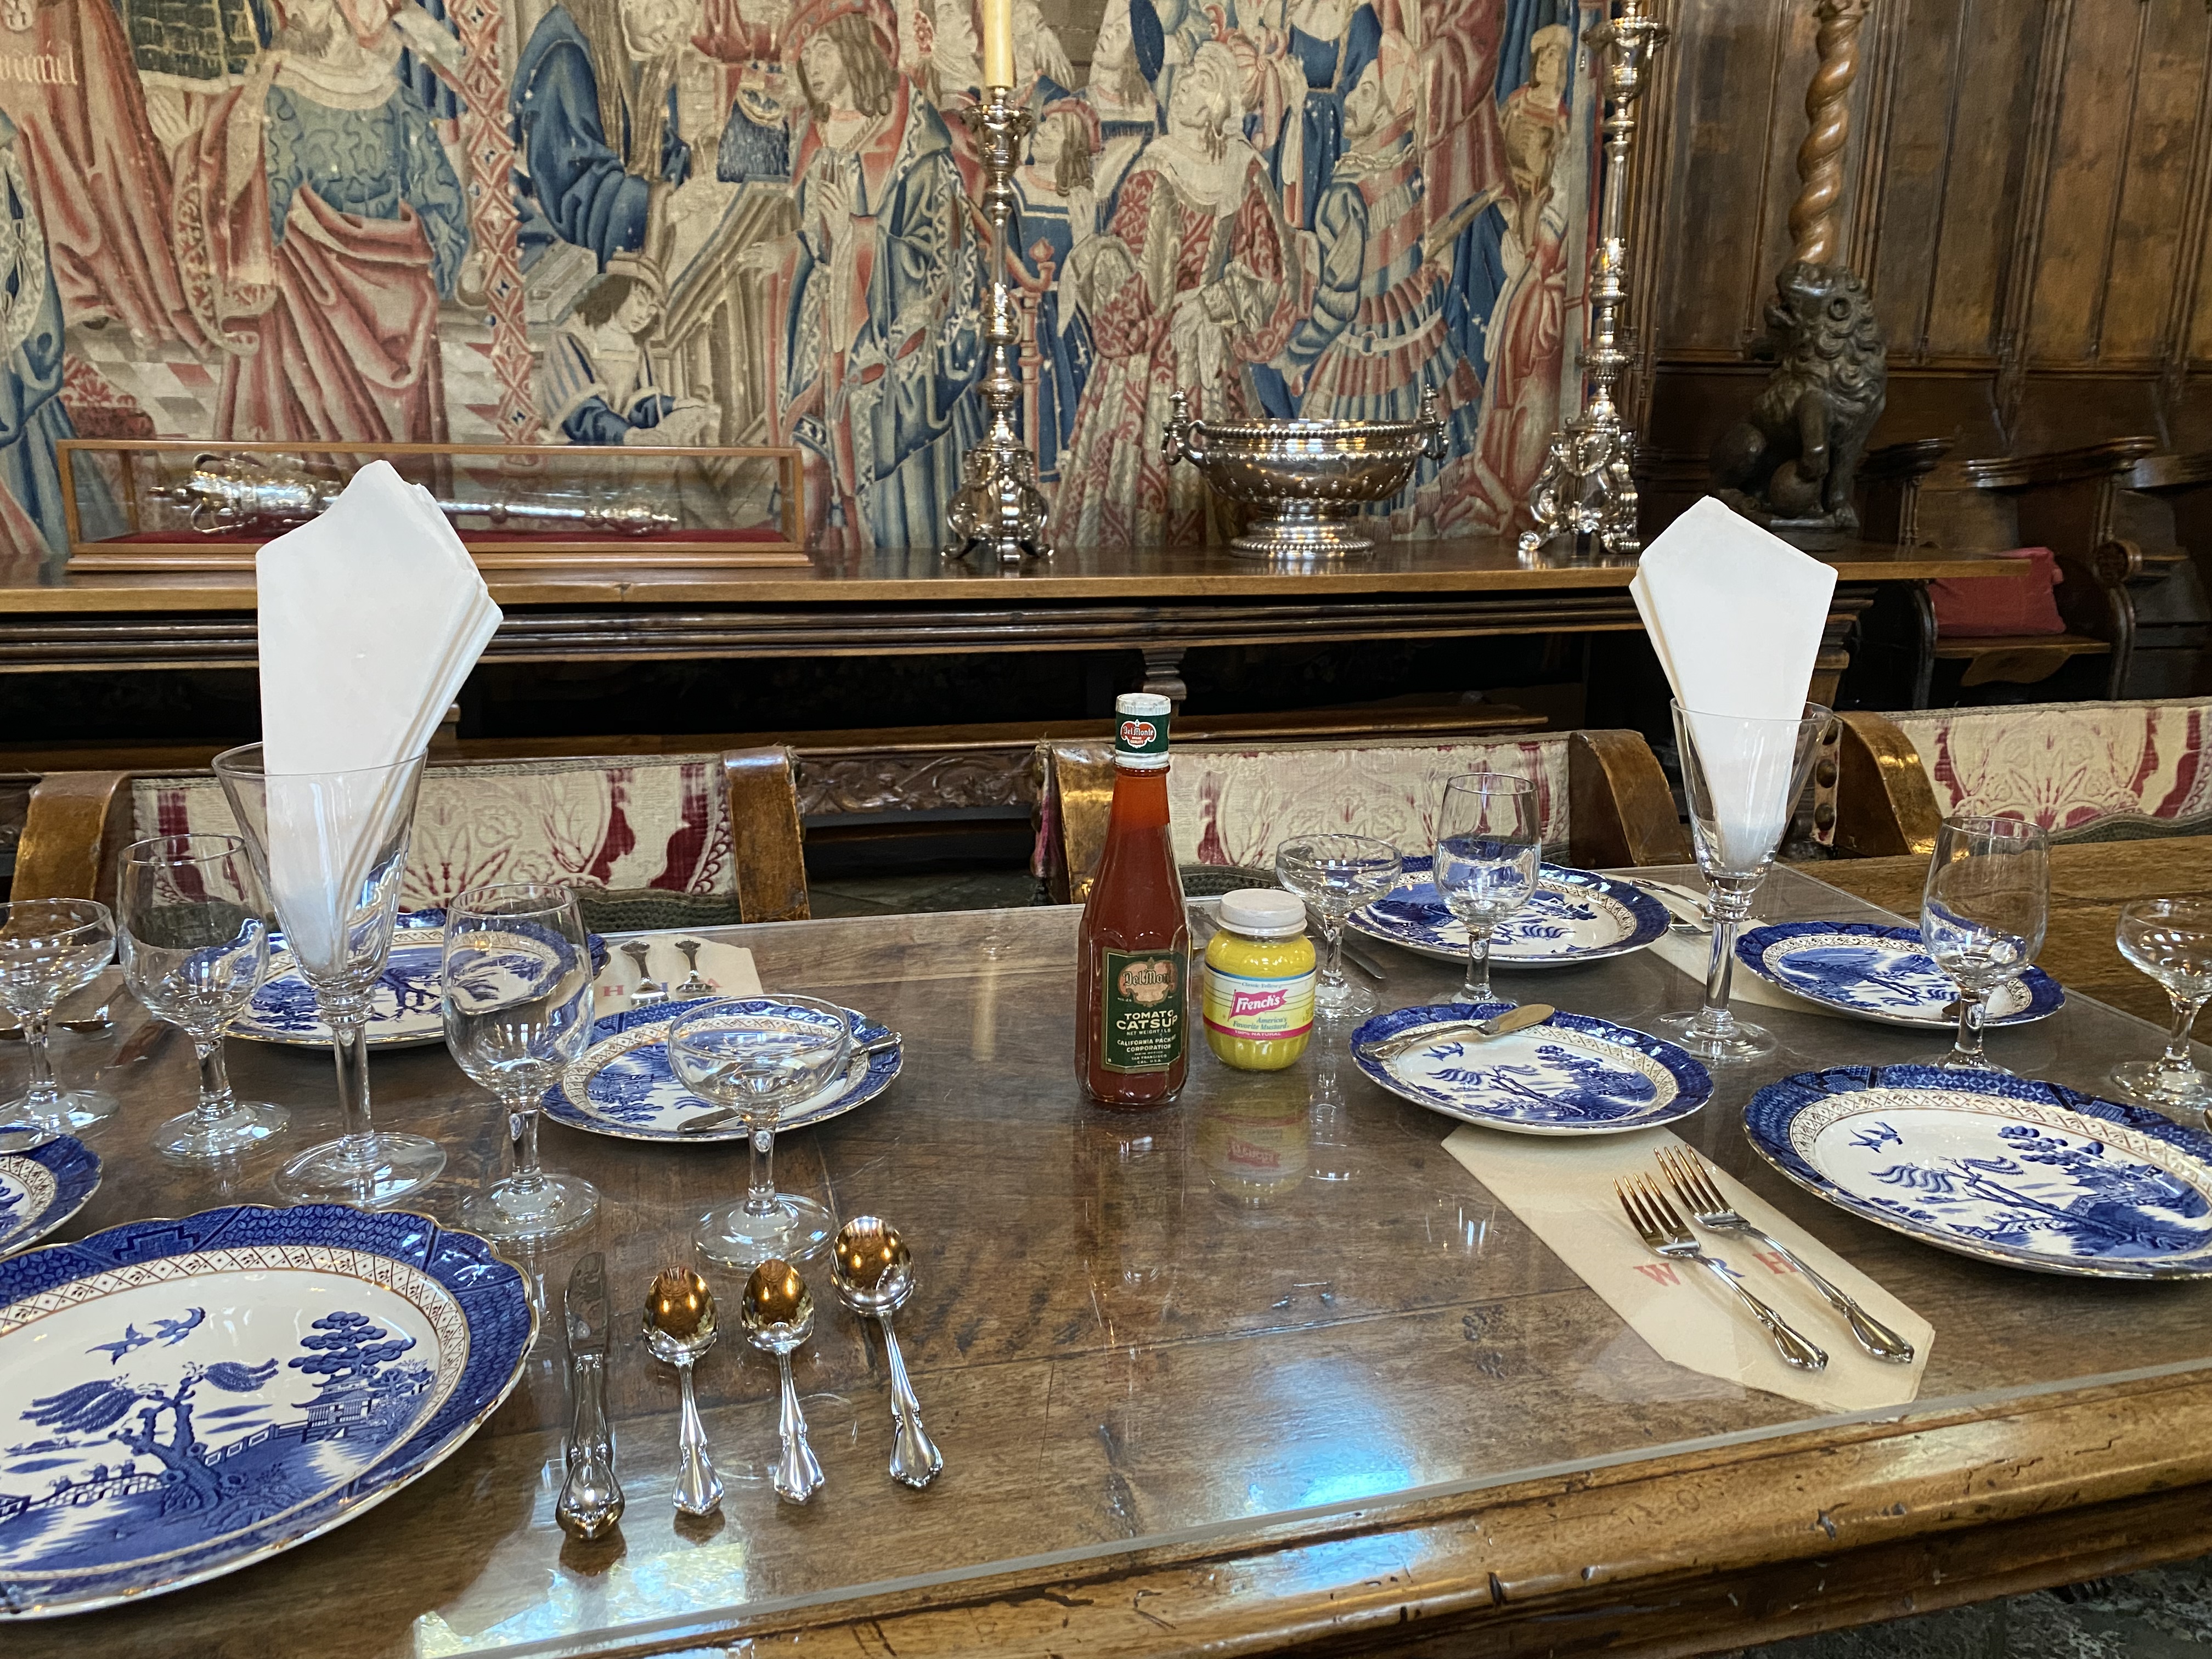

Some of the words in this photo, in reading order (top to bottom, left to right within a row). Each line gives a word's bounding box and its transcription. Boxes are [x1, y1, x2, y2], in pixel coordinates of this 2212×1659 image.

[1235, 994, 1280, 1013] French's
[1124, 1009, 1174, 1020] TOMATO
[1116, 1015, 1178, 1030] CATSUP
[1233, 1021, 1259, 1030] Favorite
